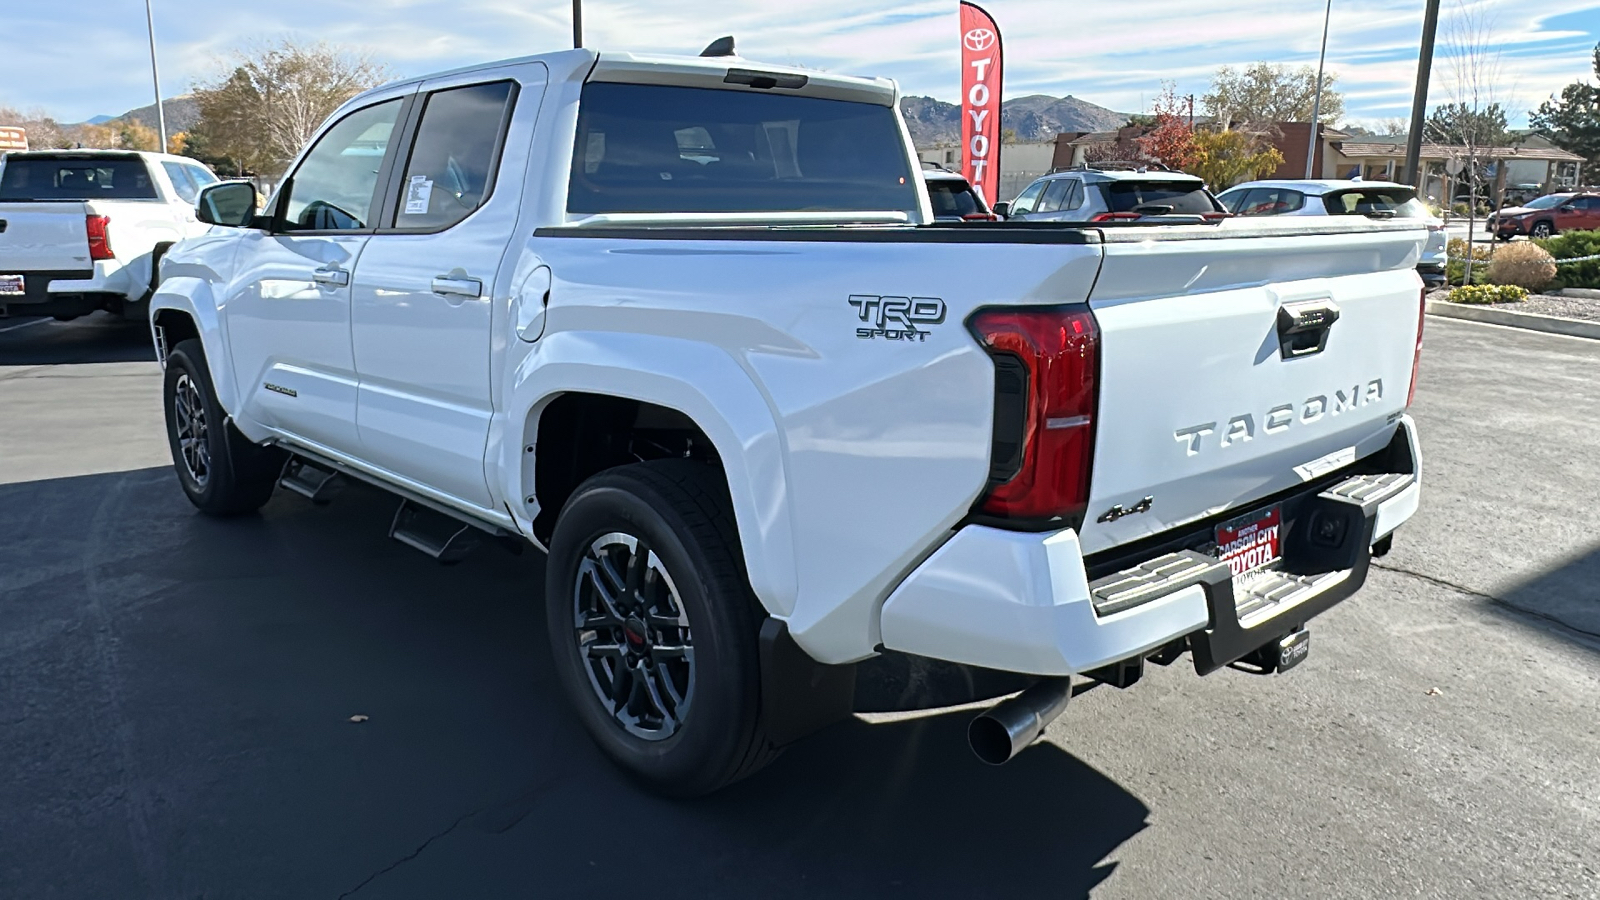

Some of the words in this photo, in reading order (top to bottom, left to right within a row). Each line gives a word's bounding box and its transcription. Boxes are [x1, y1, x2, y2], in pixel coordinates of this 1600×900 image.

[968, 58, 991, 202] TOYOTA
[848, 294, 947, 330] TRD
[856, 328, 931, 342] SPORT
[1174, 378, 1383, 457] TACOMA
[1218, 532, 1256, 561] CARSON
[1257, 524, 1279, 544] CITY
[1227, 542, 1273, 576] TOYOTA
